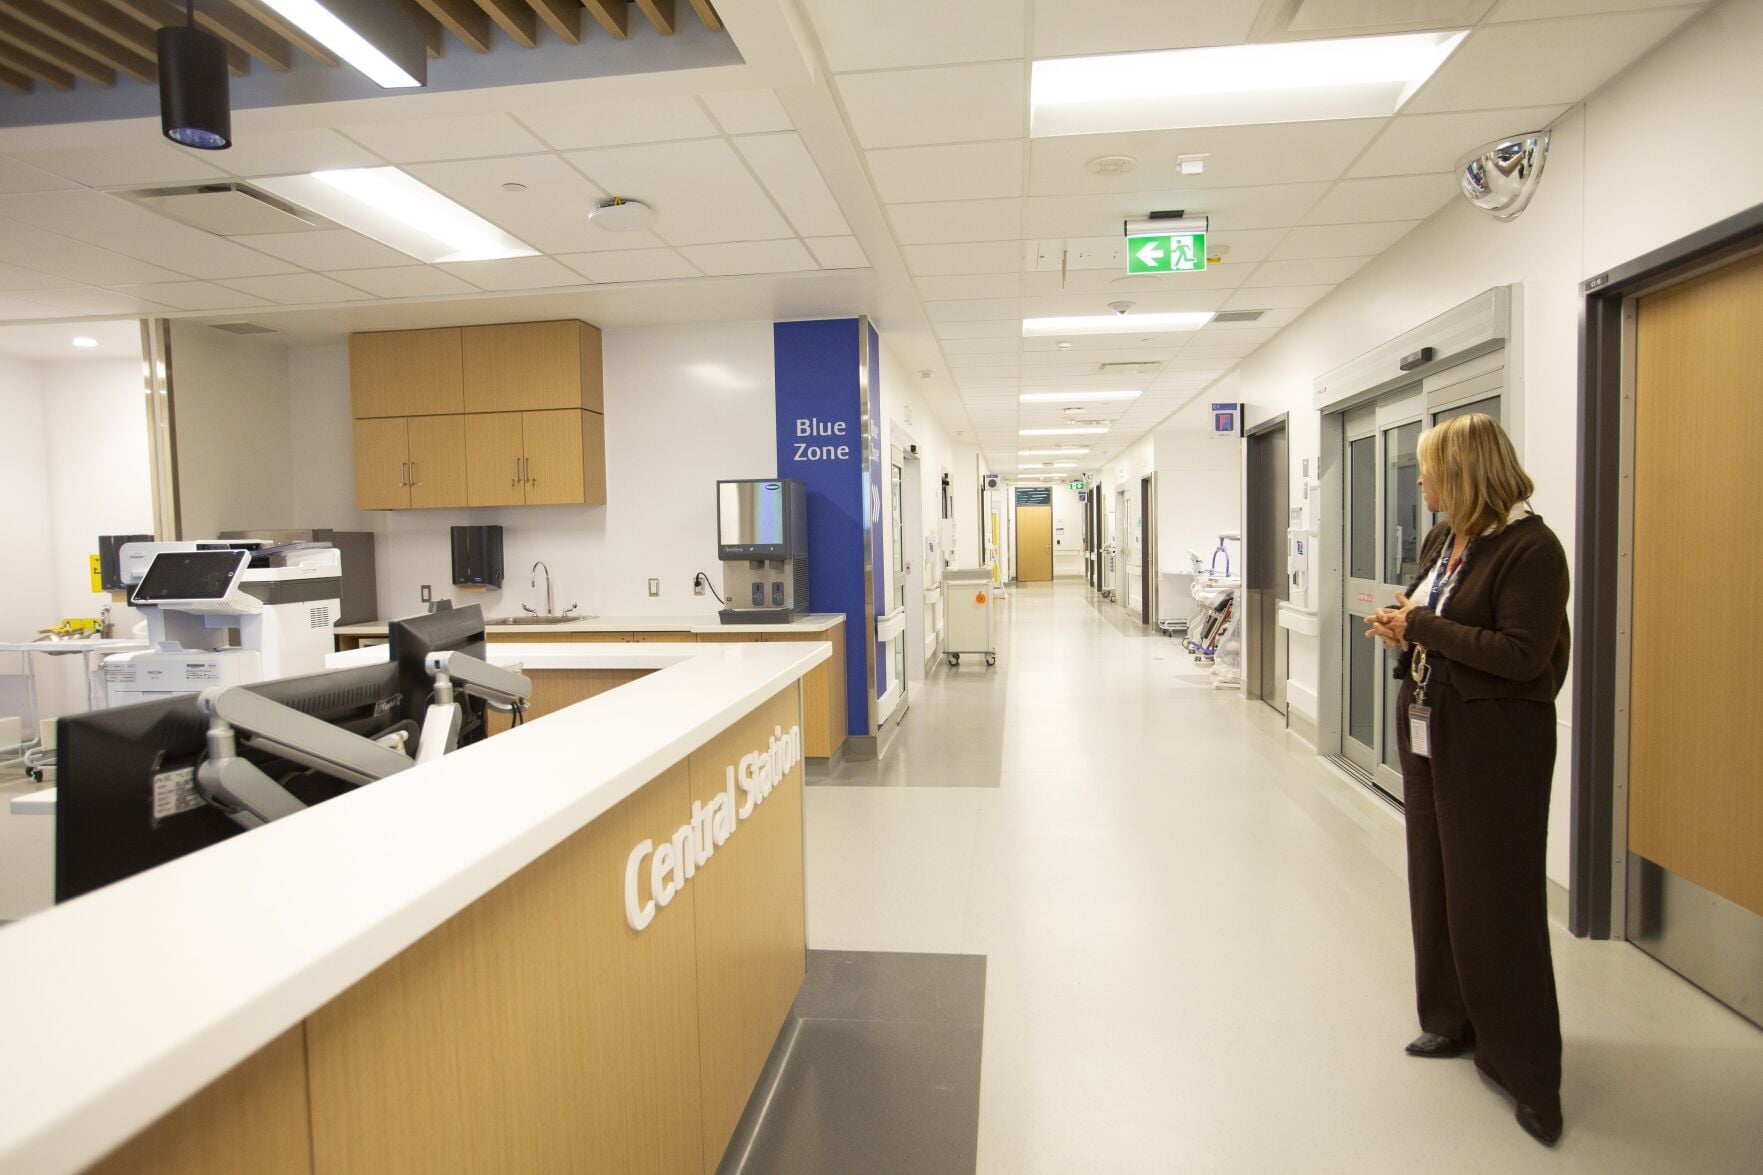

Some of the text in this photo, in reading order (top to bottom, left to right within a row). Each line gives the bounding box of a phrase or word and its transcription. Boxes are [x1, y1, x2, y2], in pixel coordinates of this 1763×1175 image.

[796, 418, 846, 437] Blue
[793, 444, 849, 461] Zone
[624, 725, 800, 931] Central Station
